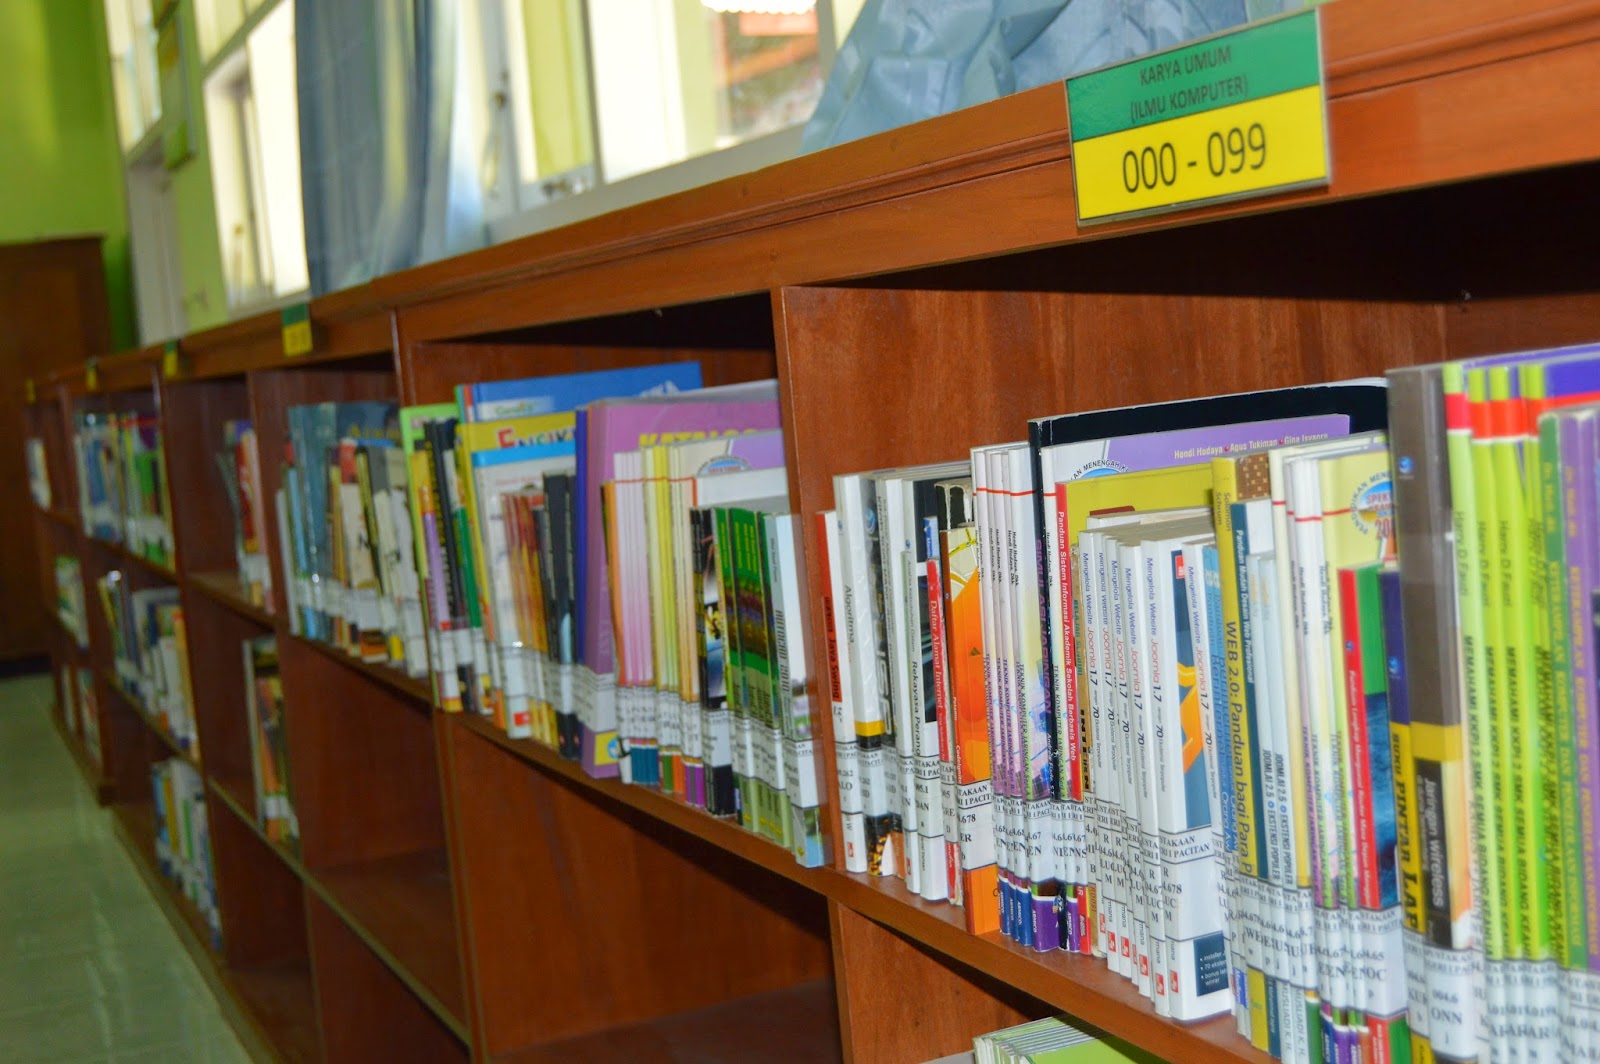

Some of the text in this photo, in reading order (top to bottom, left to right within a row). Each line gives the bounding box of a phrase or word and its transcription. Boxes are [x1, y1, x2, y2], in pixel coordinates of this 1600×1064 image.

[1140, 45, 1232, 86] KARYA UMUM
[1130, 75, 1248, 123] (ILMU KOMPUTER)
[1122, 142, 1177, 193] 000
[1207, 122, 1266, 177] 099
[1174, 449, 1194, 459] Hendi
[1230, 439, 1278, 453] Agus Tukiman
[1284, 435, 1300, 444] Gina
[1236, 530, 1245, 564] Panduan
[1111, 560, 1120, 600] Mengelola
[1147, 558, 1156, 600] Mengelola
[1239, 565, 1247, 592] Mudah
[844, 585, 855, 643] Algoritma
[1241, 593, 1250, 620] Desain
[828, 639, 837, 661] Java
[930, 601, 943, 708] Daftar Alamat Internet
[1116, 638, 1126, 680] Joomla
[1125, 568, 1134, 609] Mengelola
[1131, 648, 1140, 691] Joomla
[1137, 732, 1144, 745] 70
[1151, 638, 1160, 682] Joomla
[1187, 567, 1196, 608] Mengelola
[1196, 647, 1206, 690] Joomla
[1205, 732, 1212, 745] 70
[1244, 640, 1254, 684] Profesional
[830, 665, 840, 698] Swing
[912, 661, 920, 714] Rekayasa
[1065, 668, 1073, 702] Sekolah
[1088, 627, 1096, 668] Joomla
[1093, 707, 1099, 718] 70
[1103, 628, 1111, 669] Joomla
[1108, 708, 1114, 720] 70
[1119, 682, 1127, 698] 1.7
[1153, 685, 1161, 702] 1.7
[1464, 636, 1476, 710] MEMAHAMI
[1054, 695, 1062, 735] KOMPUTER
[1067, 704, 1076, 740] Berbasis
[1122, 720, 1129, 732] 70
[1157, 725, 1163, 738] 70
[1211, 654, 1224, 757] Berinternet
[1220, 792, 1231, 829] Orang
[1226, 621, 1251, 859] WEB 2.0: Panduan bagi Para
[1473, 762, 1483, 789] SMK
[1560, 747, 1573, 776] DAN
[1580, 754, 1593, 783] DAN
[1392, 734, 1411, 862] BUKU PINTAR
[1475, 794, 1486, 840] SEMUA
[1174, 844, 1210, 858] PACITAN
[1266, 785, 1280, 879] 2.5 EKSTENSI POPULER
[1278, 789, 1293, 884] 2.5 EKSTENSI POPULER
[1424, 777, 1444, 907] Jaringan wireless
[1281, 983, 1291, 1030] MUSLIADI
[1294, 988, 1305, 1038] MUSLIADI
[1431, 1008, 1462, 1024] ONN
